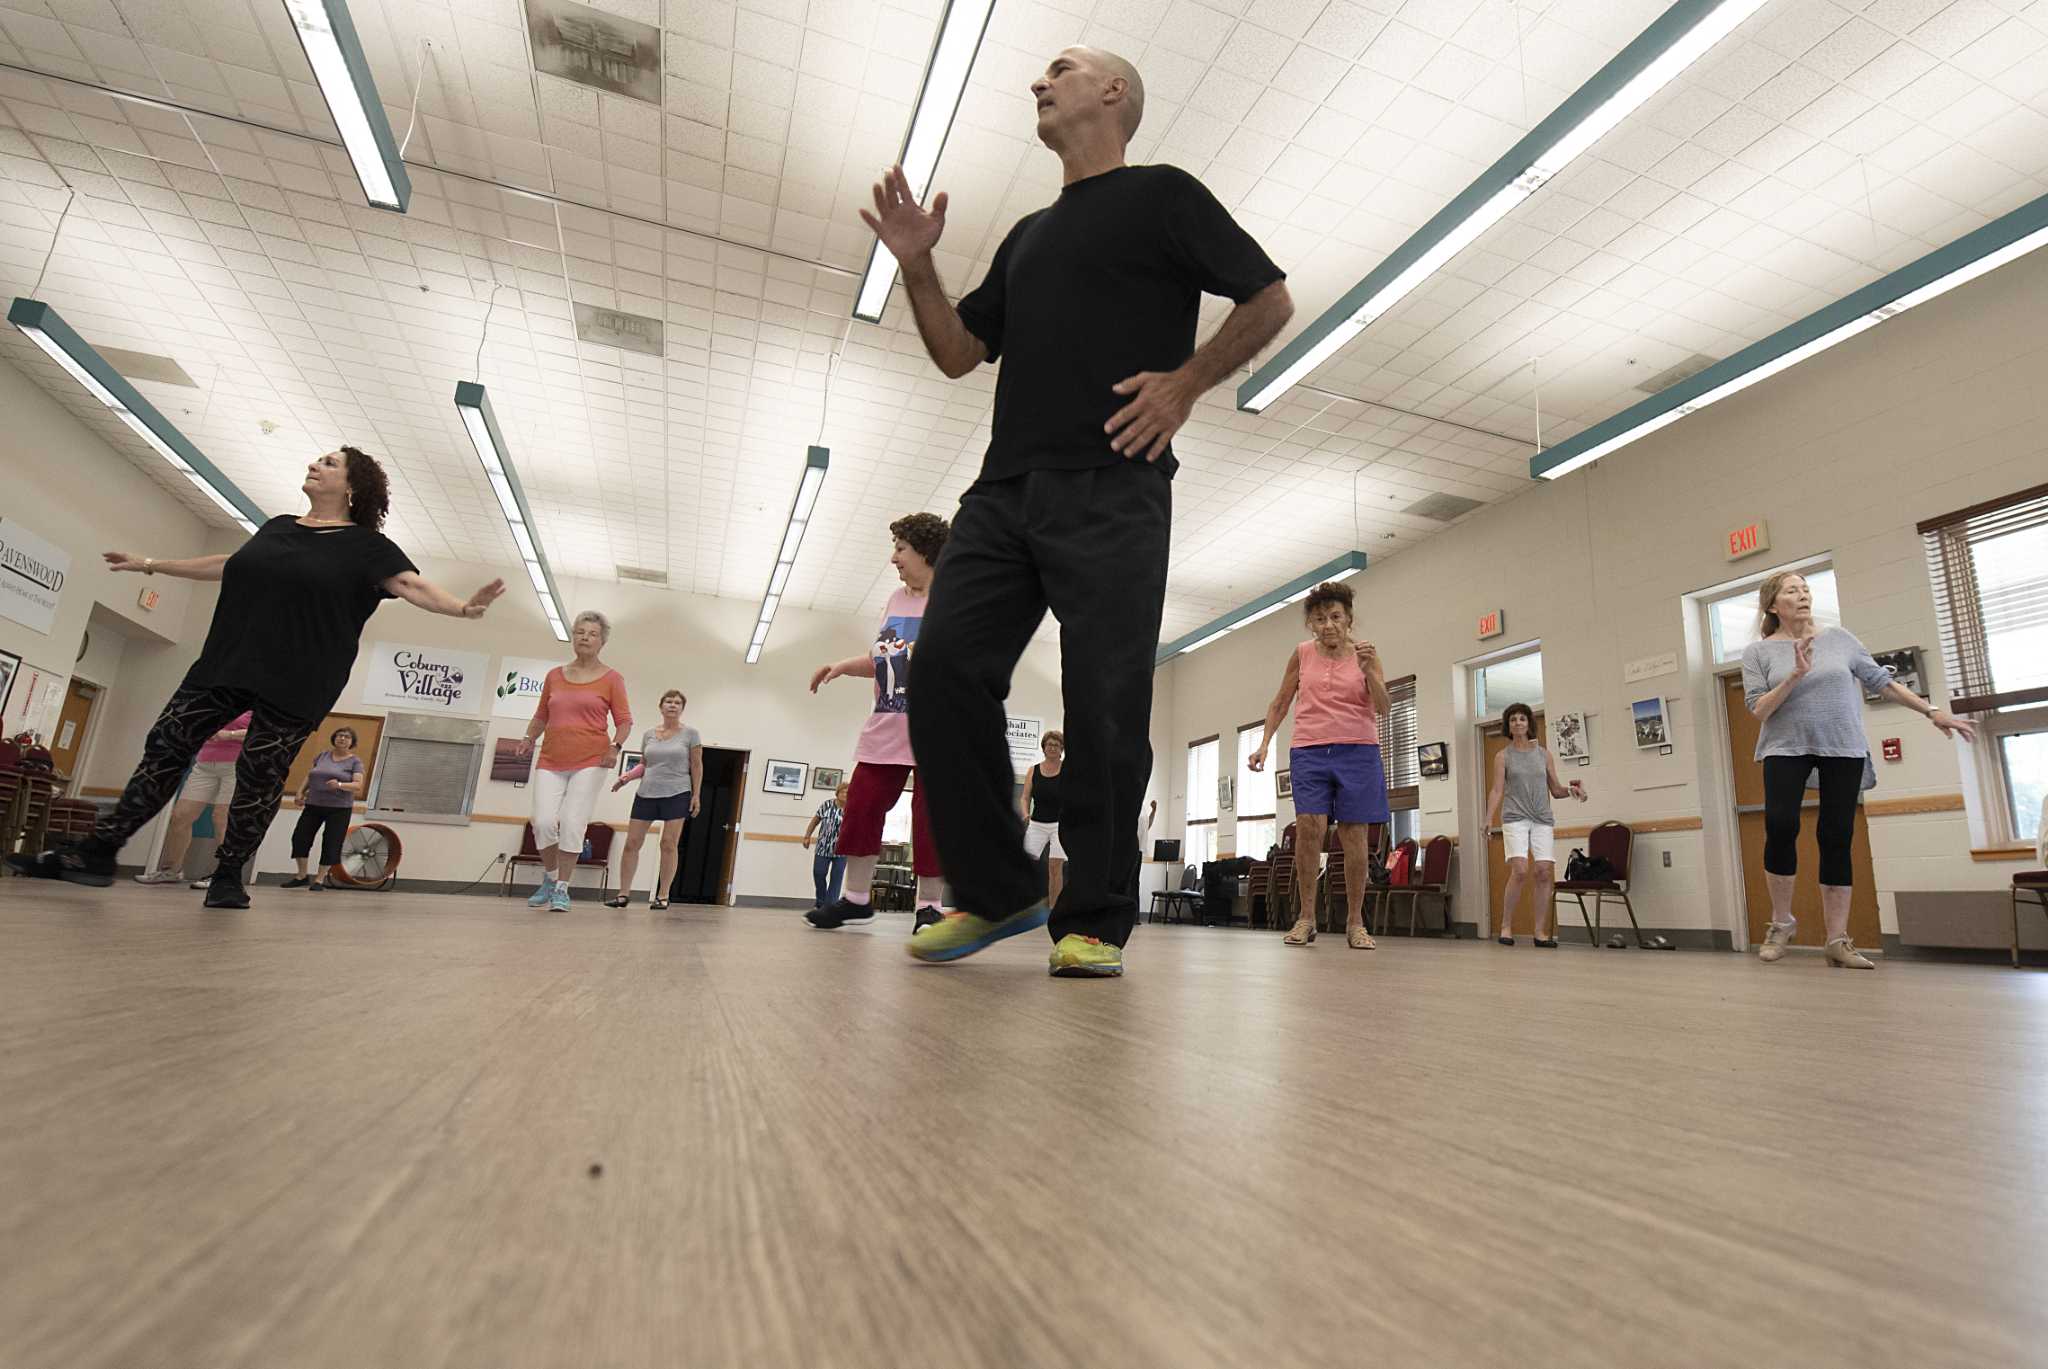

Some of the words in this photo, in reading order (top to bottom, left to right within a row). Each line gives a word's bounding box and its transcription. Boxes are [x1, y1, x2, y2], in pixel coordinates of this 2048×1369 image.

[1729, 526, 1758, 555] EXIT
[1480, 612, 1497, 635] EXIT
[394, 652, 449, 678] Coburg
[397, 670, 462, 705] Village
[1006, 730, 1037, 738] ociates
[1008, 721, 1026, 729] hall
